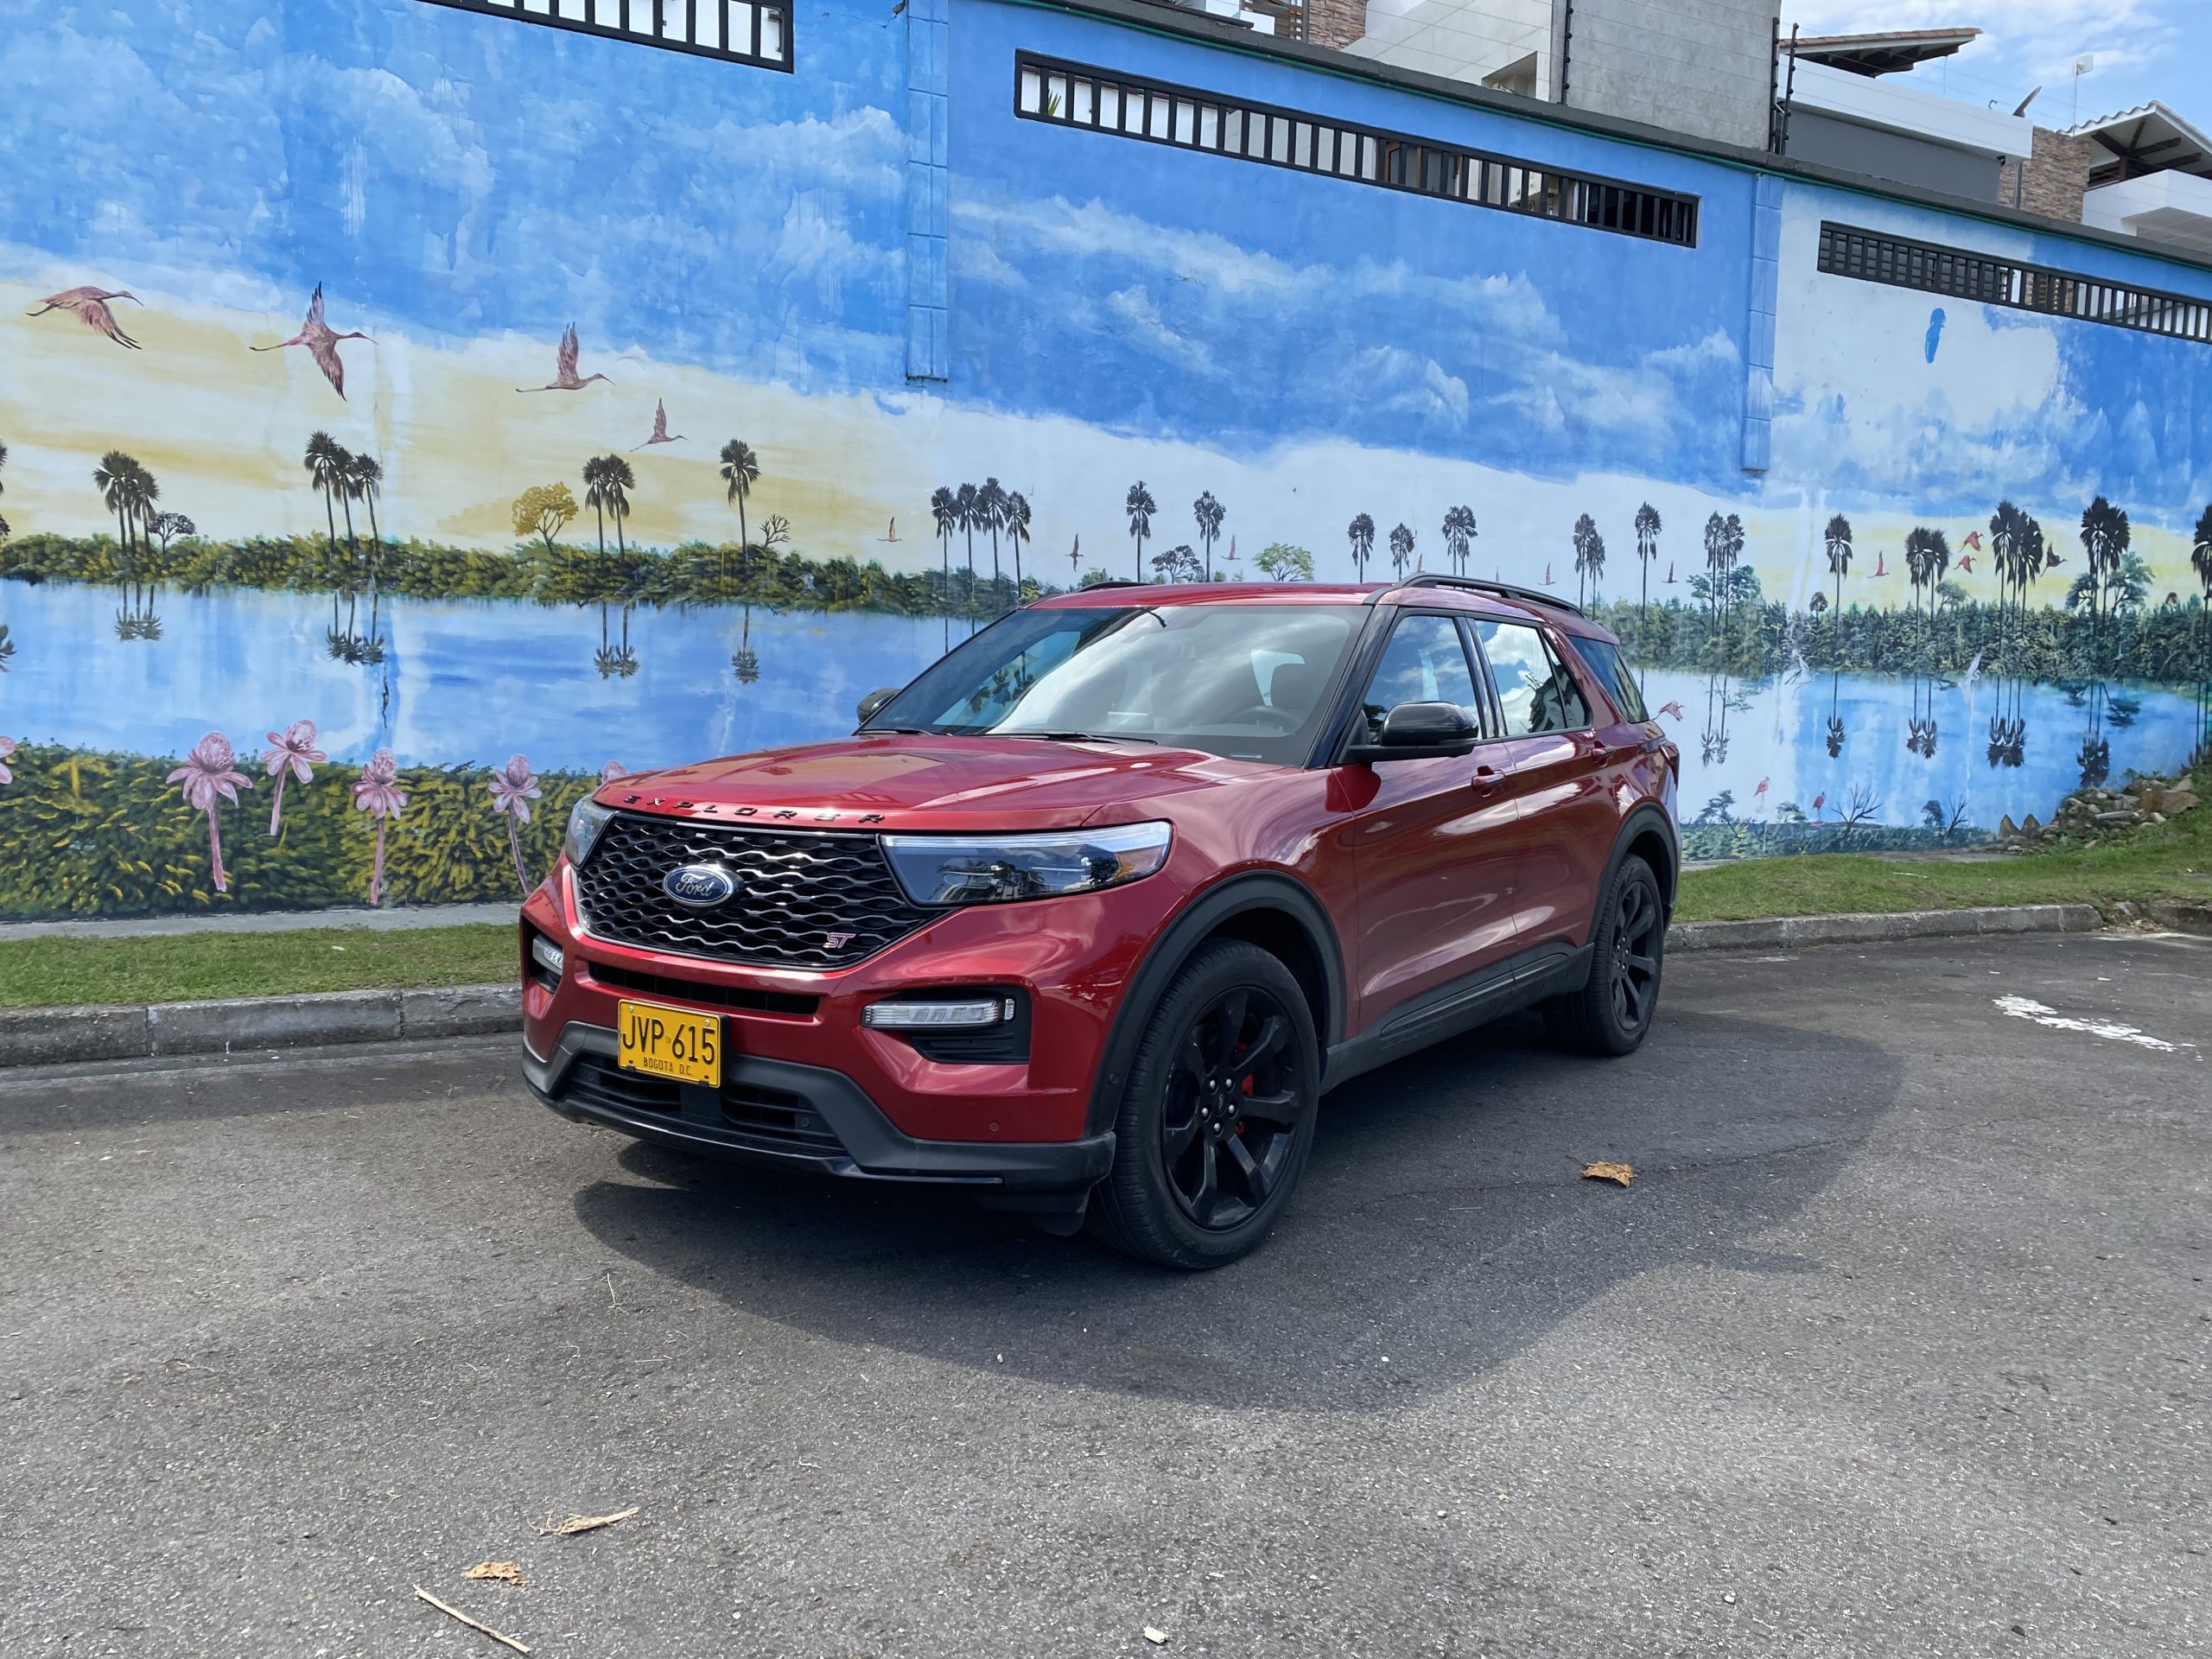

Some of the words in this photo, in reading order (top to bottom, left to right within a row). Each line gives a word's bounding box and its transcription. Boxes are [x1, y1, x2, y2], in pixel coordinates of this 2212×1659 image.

[623, 794, 886, 823] EXPLORER
[675, 872, 715, 898] Ford
[822, 931, 856, 949] ST
[622, 1014, 664, 1054] JVP
[671, 1023, 716, 1065] 615
[643, 1056, 673, 1072] BOGOTA
